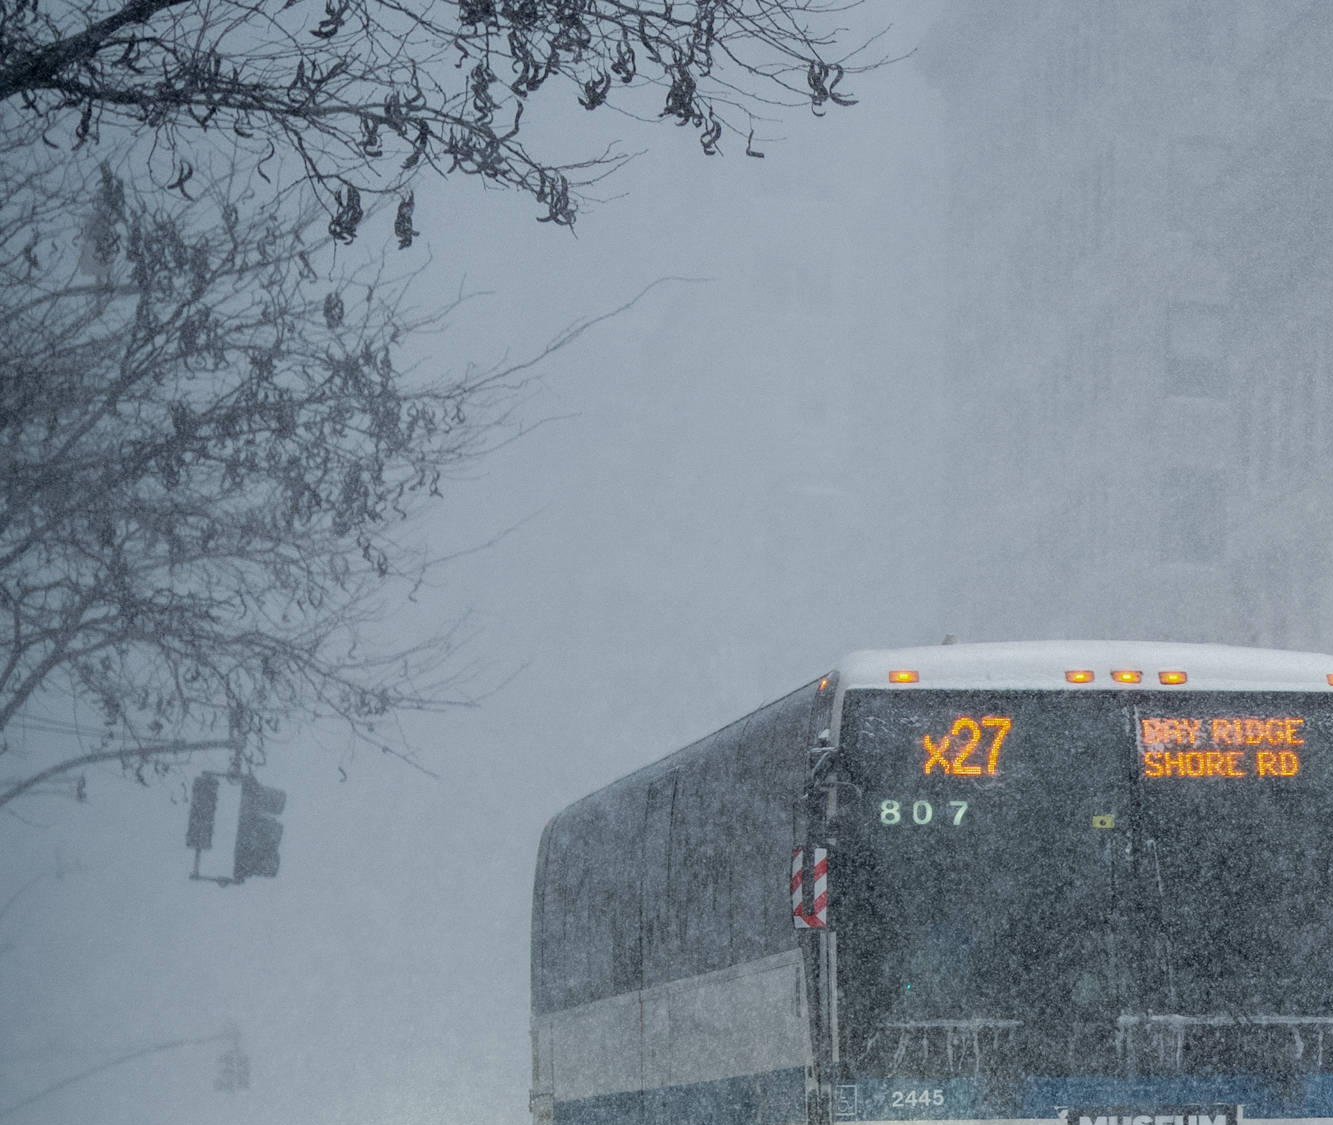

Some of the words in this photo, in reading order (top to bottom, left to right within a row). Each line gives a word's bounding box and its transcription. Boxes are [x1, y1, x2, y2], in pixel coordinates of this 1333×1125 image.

[1212, 719, 1305, 745] RIDGE
[1144, 752, 1246, 778] SHORE
[1257, 752, 1299, 778] RD
[891, 1089, 945, 1107] 2445
